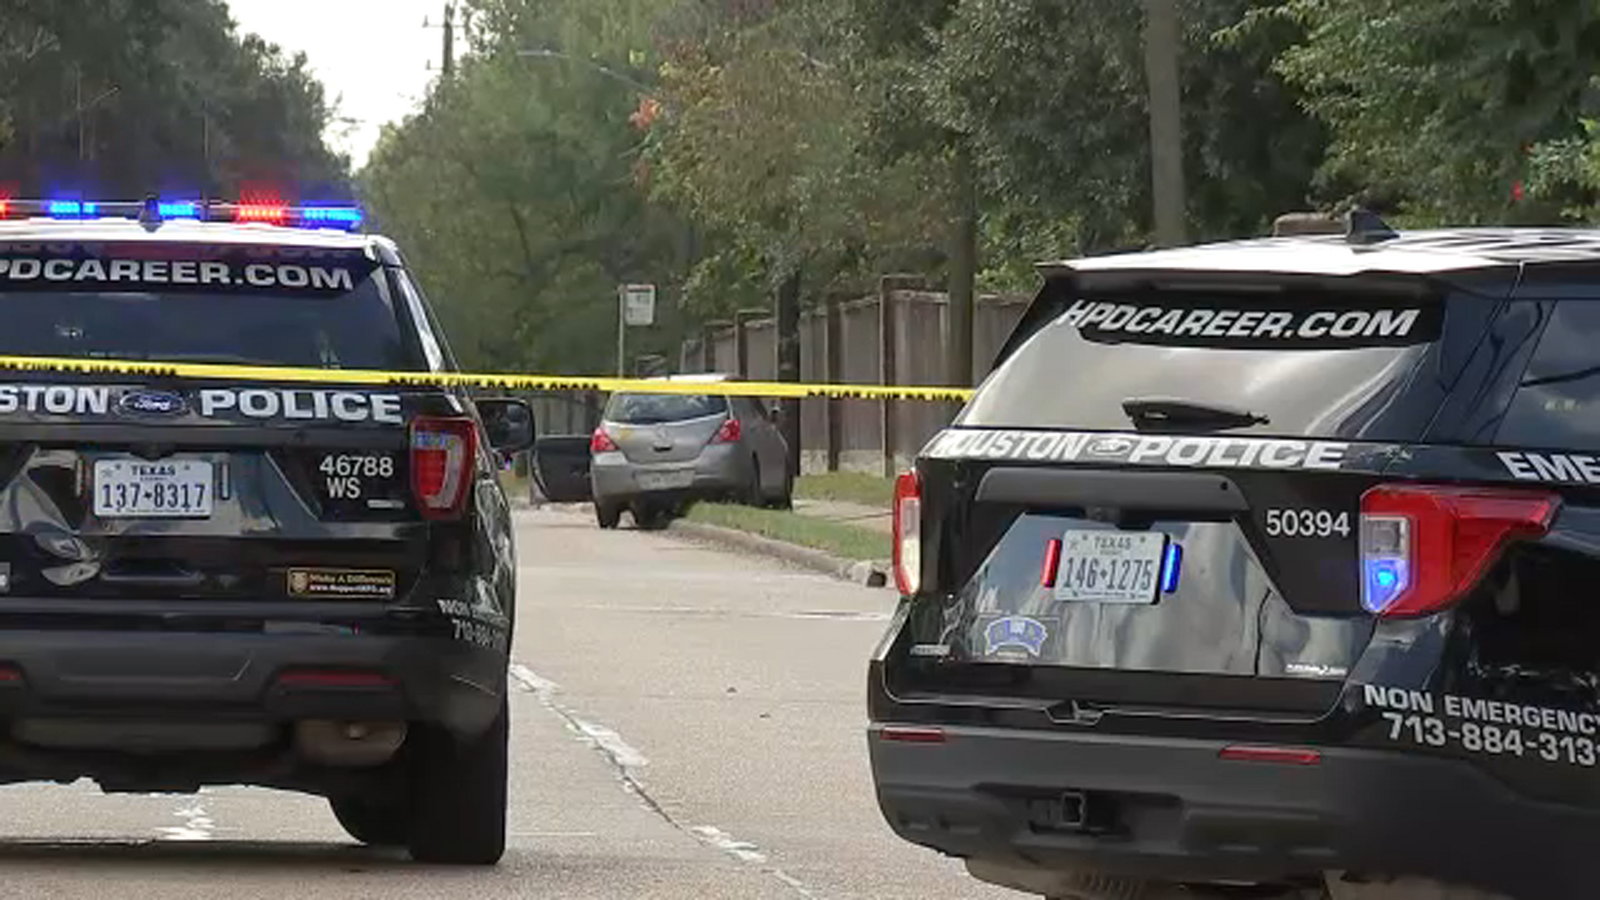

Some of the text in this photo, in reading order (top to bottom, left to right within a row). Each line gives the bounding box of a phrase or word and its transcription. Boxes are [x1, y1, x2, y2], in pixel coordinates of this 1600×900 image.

[1053, 299, 1420, 338] HPDCAREER.COM
[0, 385, 109, 414] STON
[200, 389, 403, 425] POLICE
[319, 454, 394, 478] 46788
[1128, 436, 1349, 470] POLICE
[1496, 451, 1600, 483] EME
[131, 464, 176, 476] TEXAS
[326, 476, 361, 499] WS
[1265, 509, 1350, 537] 50394
[1095, 537, 1132, 550] TEXAS
[1363, 684, 1434, 713] NON
[1382, 711, 1600, 767] 713-884-313
